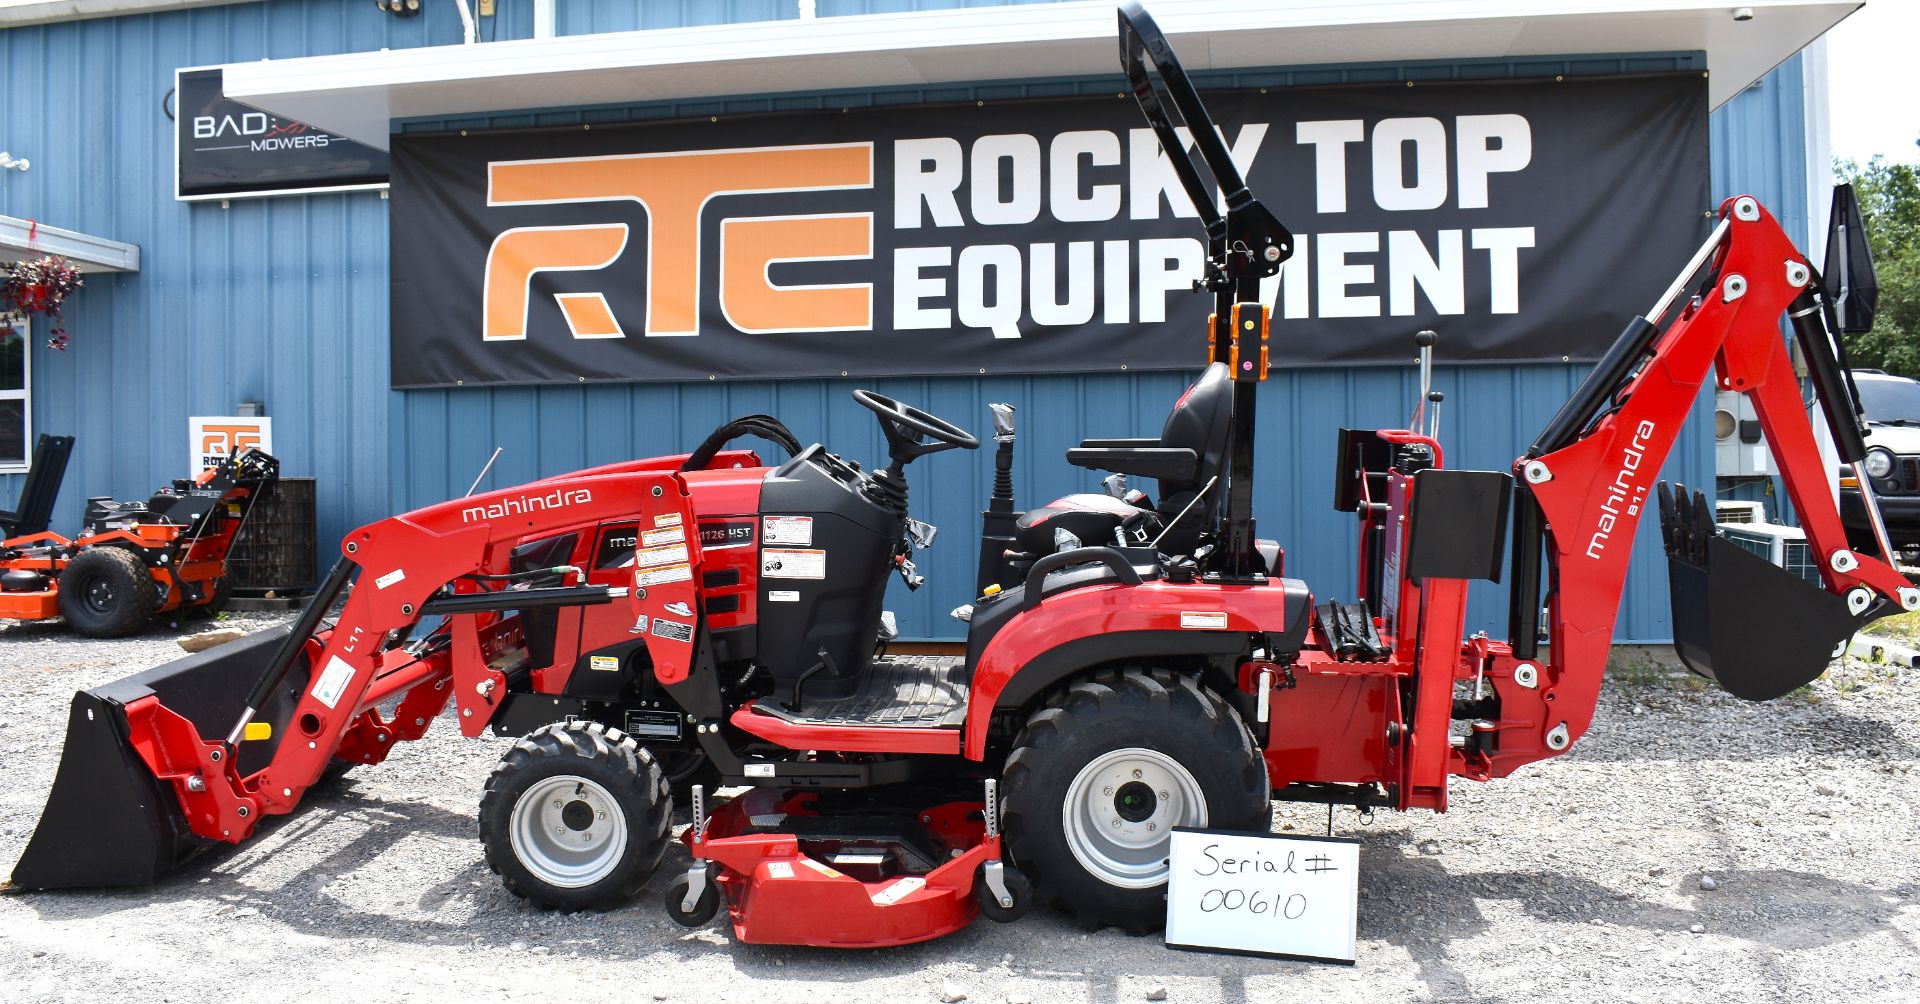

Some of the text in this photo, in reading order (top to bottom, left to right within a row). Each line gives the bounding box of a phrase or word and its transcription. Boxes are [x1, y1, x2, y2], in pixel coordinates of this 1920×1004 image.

[194, 112, 267, 139] BAD
[251, 135, 329, 151] MOWERS
[1296, 113, 1533, 214] TOP
[483, 141, 874, 341] RTE
[462, 488, 592, 523] mahindra
[1586, 419, 1656, 560] mahindra
[1627, 485, 1646, 517] B11
[699, 527, 751, 541] 1126 HST
[343, 626, 364, 653] L11
[1194, 844, 1339, 876] Serial #
[1200, 888, 1307, 920] 00610
